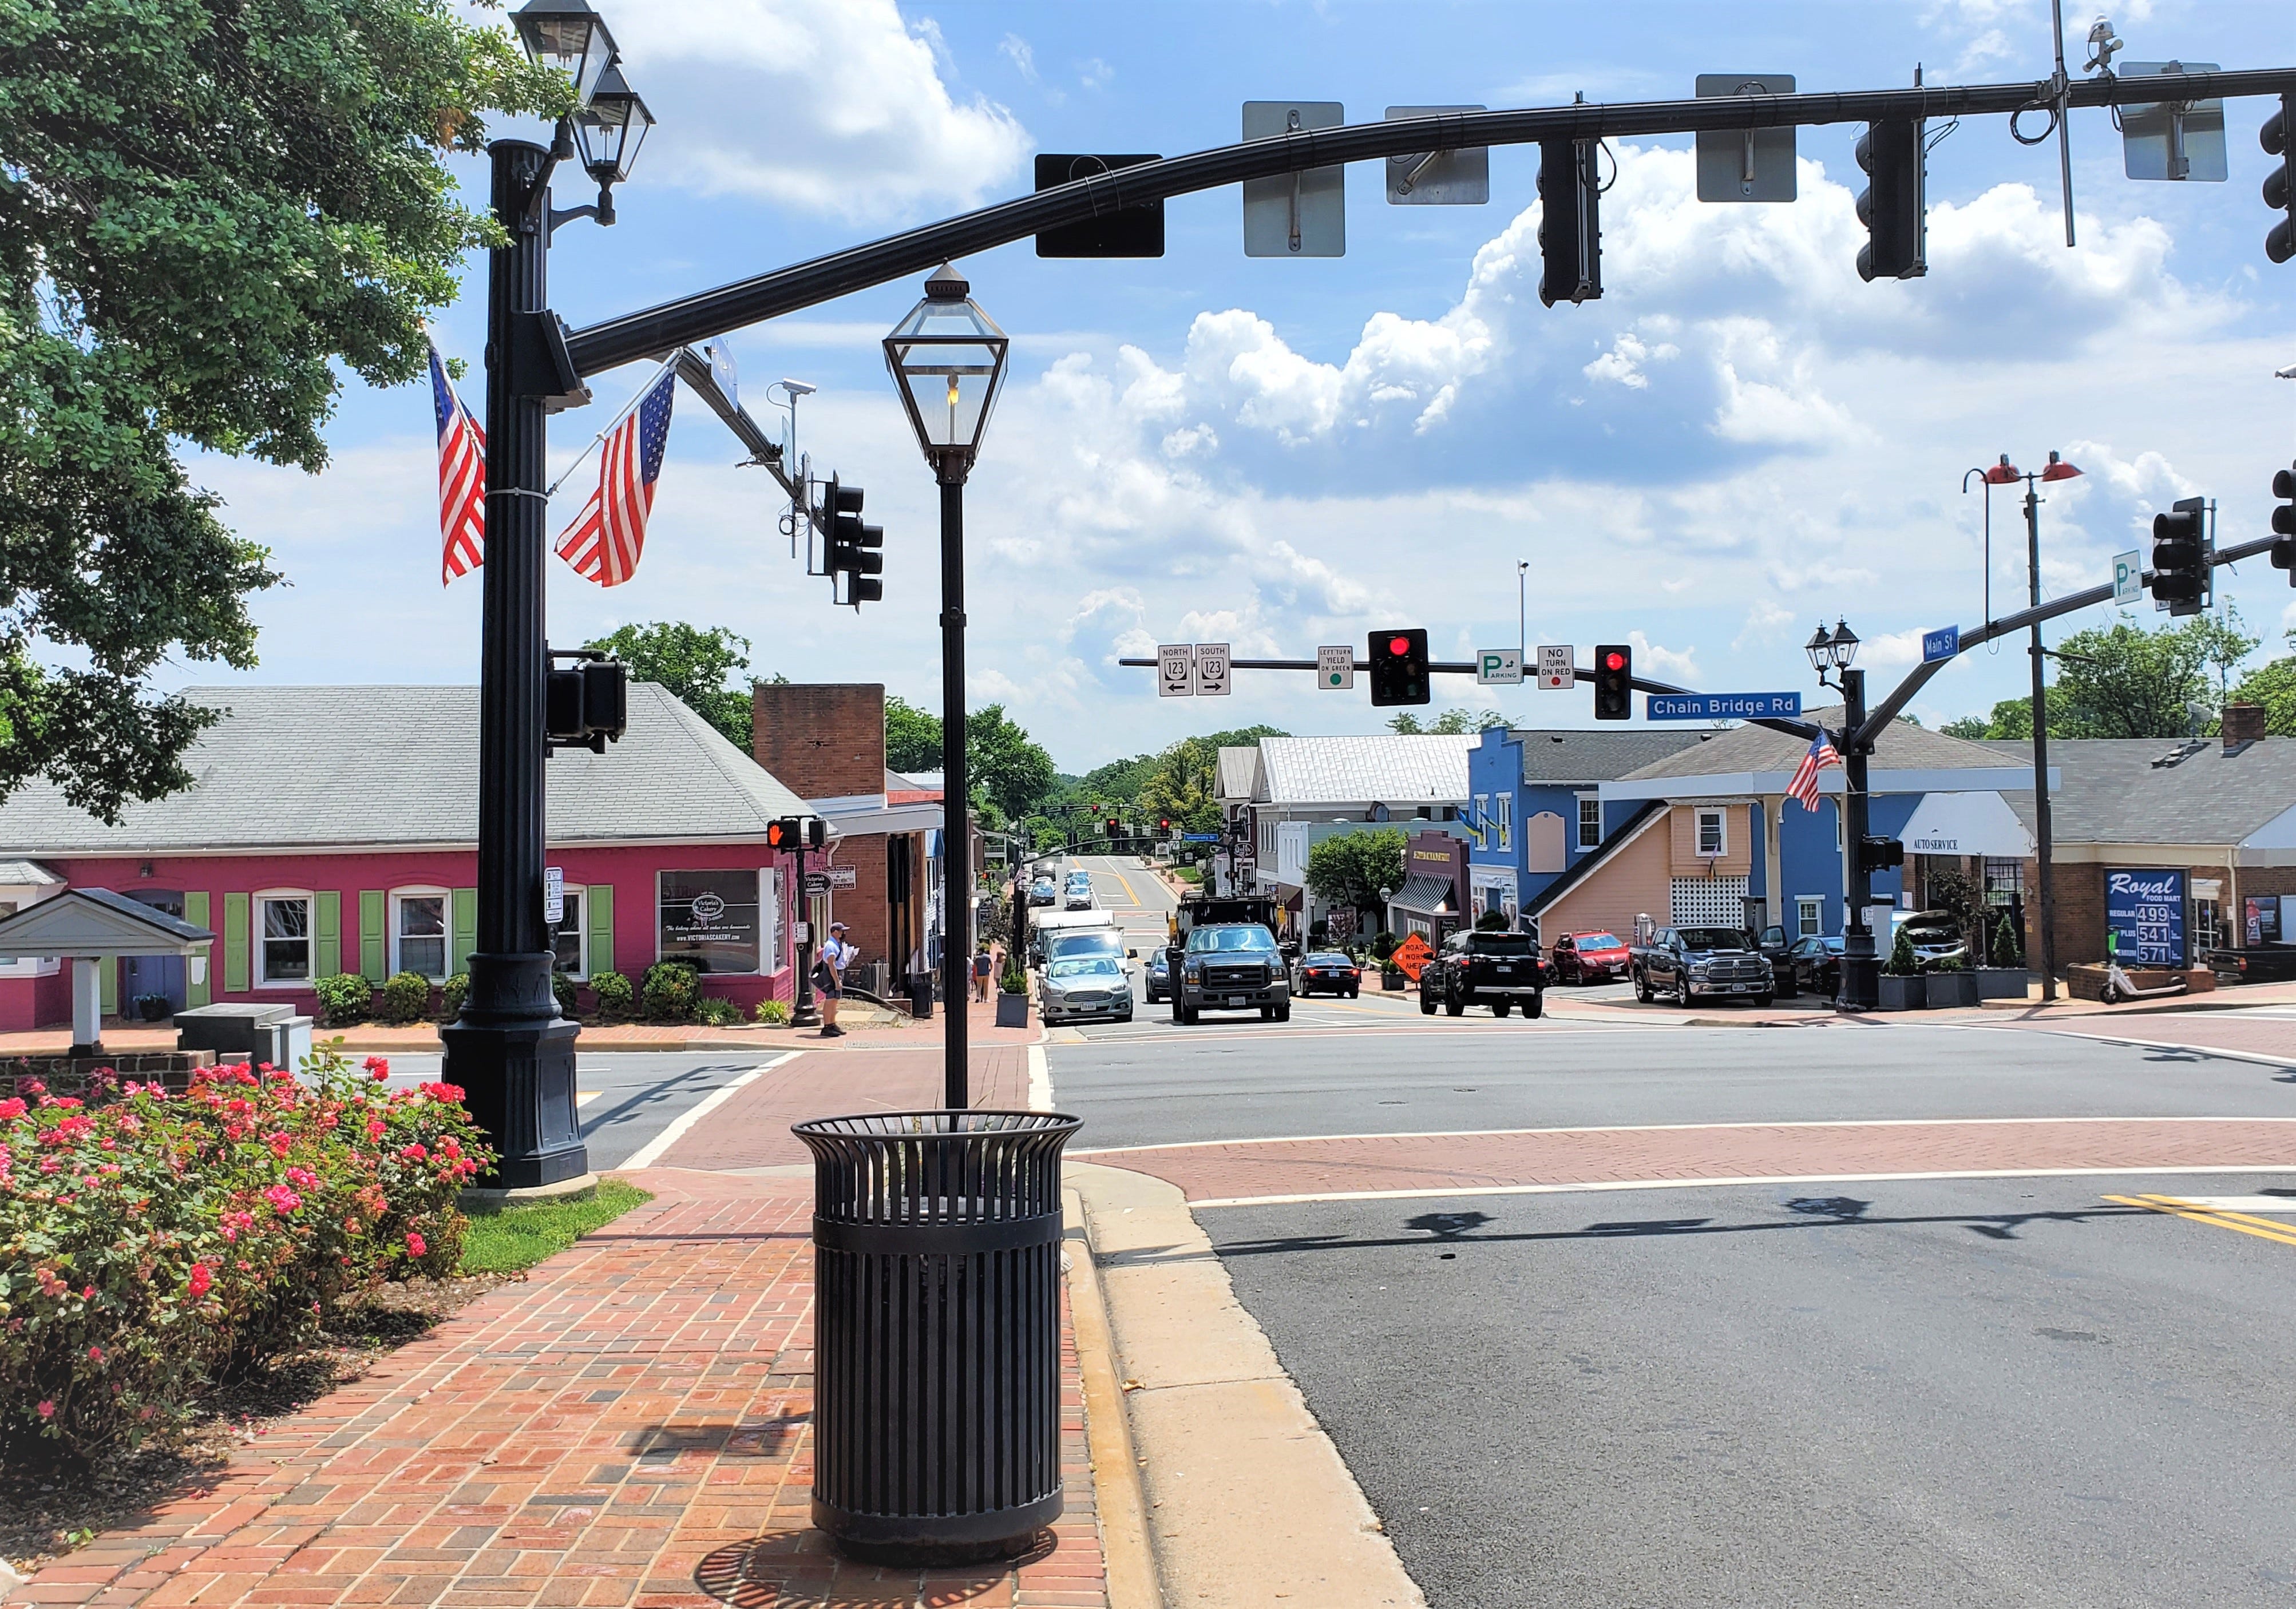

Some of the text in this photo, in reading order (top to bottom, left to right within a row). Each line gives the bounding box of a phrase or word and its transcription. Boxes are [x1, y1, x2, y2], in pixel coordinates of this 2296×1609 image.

[1926, 634, 1953, 655] Main St
[1548, 649, 1563, 657] NO
[1168, 662, 1183, 674] 123
[1205, 661, 1221, 673] 123
[1654, 698, 1794, 716] Chain Bridge Rd
[1914, 839, 1958, 850] AUTO SERVICE
[2110, 873, 2174, 899] Royal
[2137, 907, 2168, 922] 499
[2139, 927, 2167, 941] 541
[2140, 947, 2166, 961] 571
